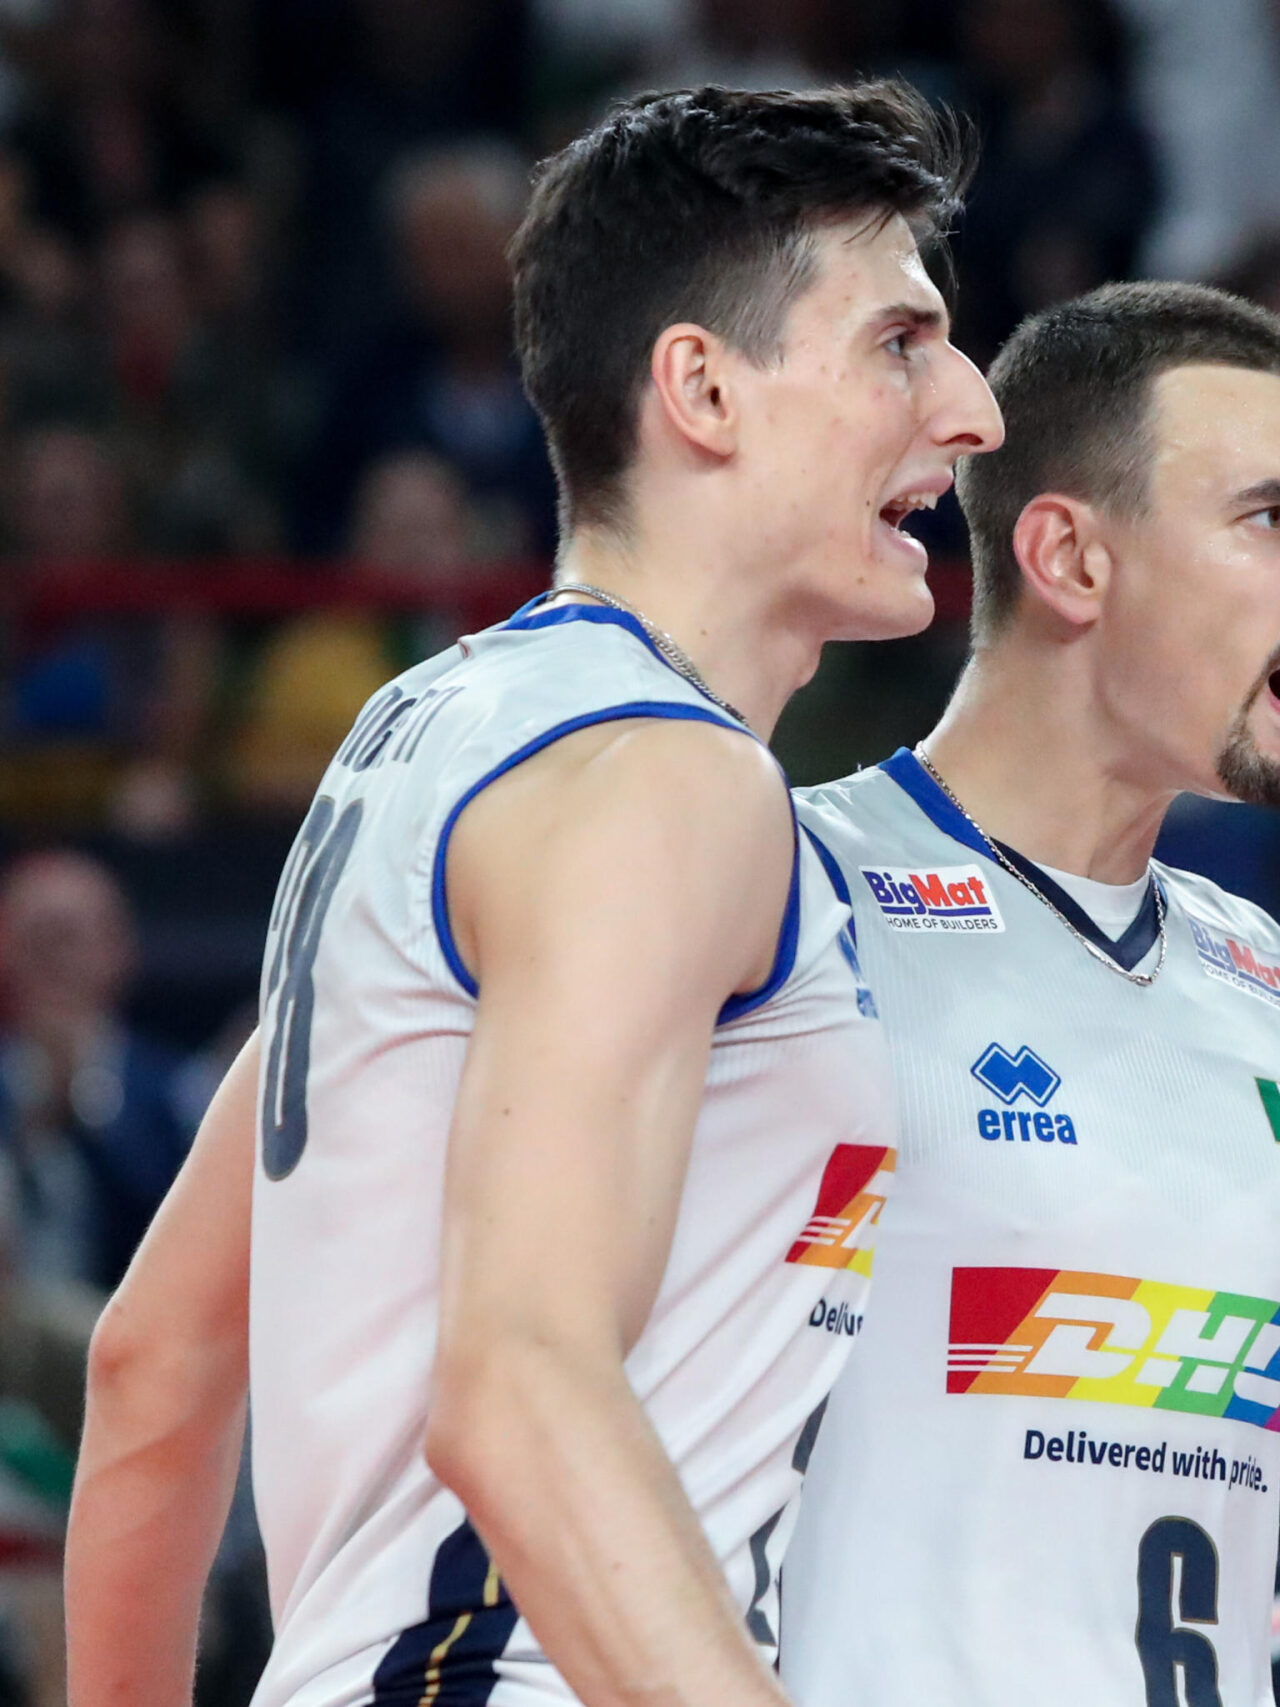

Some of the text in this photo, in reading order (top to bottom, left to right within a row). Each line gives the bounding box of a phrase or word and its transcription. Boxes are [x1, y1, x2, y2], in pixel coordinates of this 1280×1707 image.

[861, 870, 988, 915] BigMat
[886, 917, 999, 930] HOME OF BUILDERS
[977, 1108, 1079, 1145] errea
[1023, 1429, 1168, 1474] Delivered
[1172, 1446, 1227, 1482] with
[1134, 1514, 1224, 1707] 6
